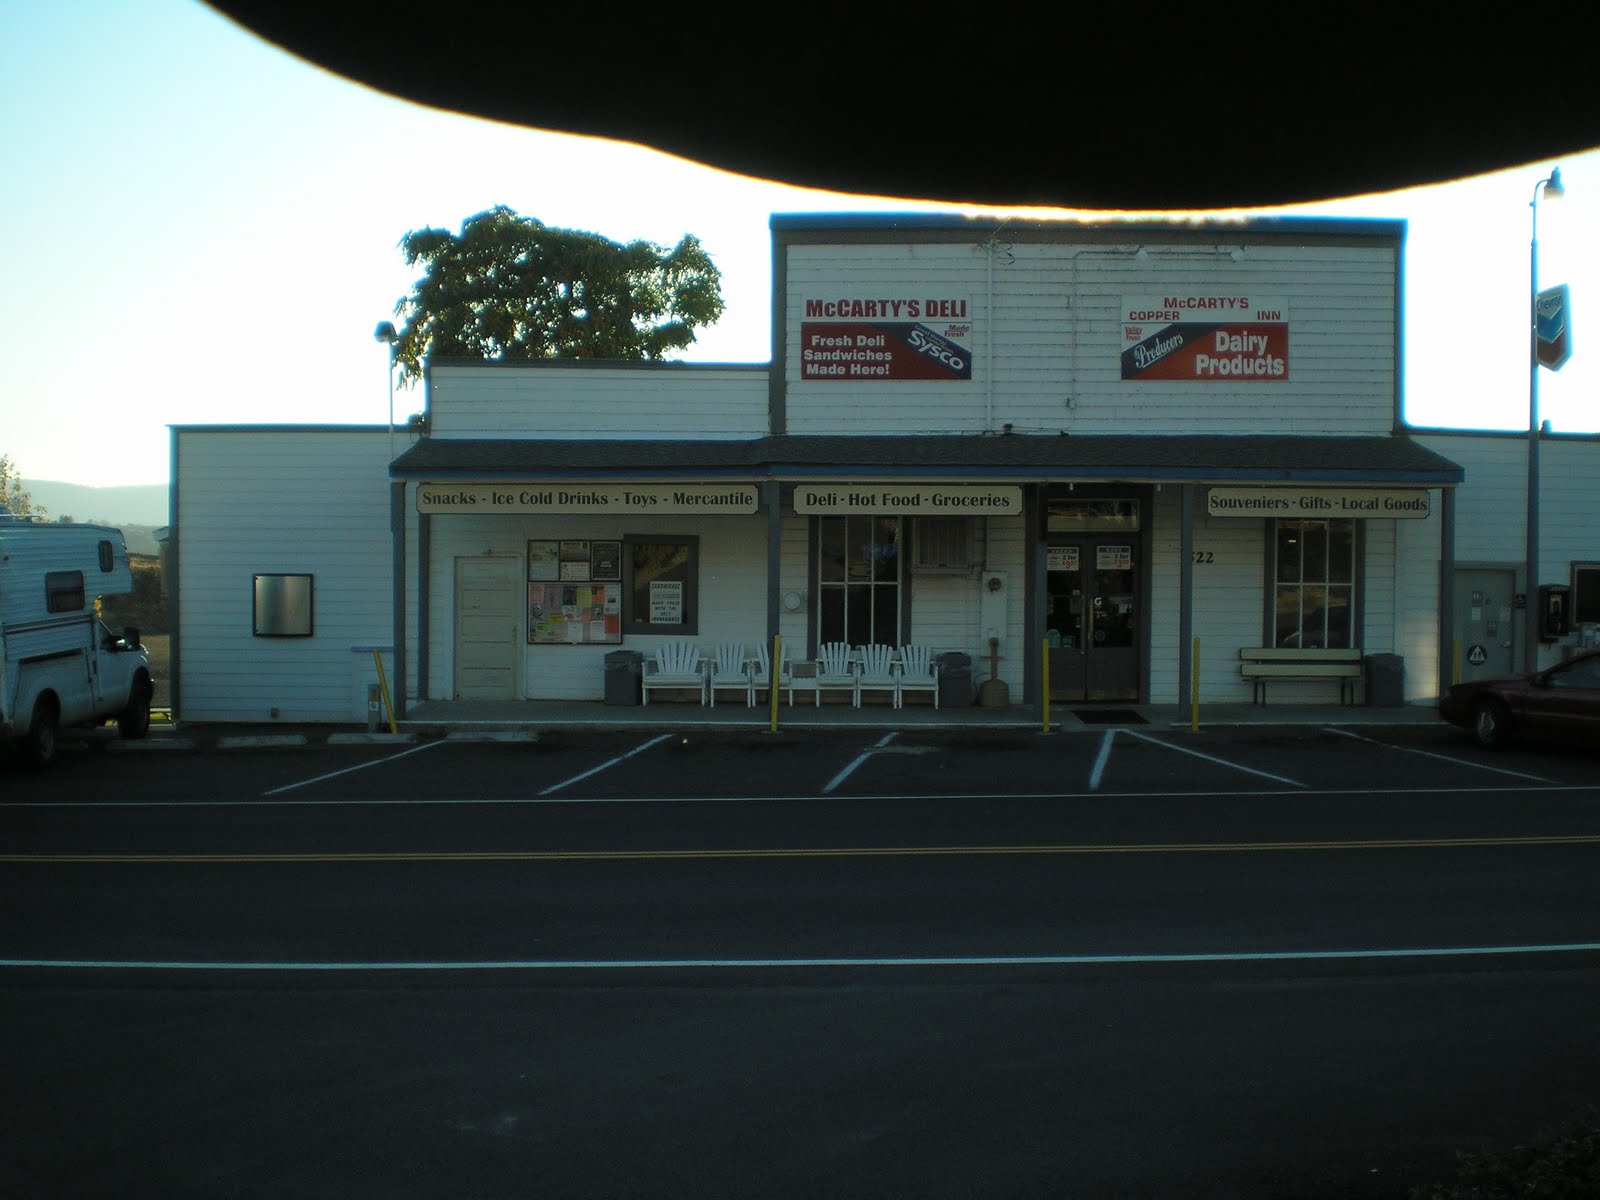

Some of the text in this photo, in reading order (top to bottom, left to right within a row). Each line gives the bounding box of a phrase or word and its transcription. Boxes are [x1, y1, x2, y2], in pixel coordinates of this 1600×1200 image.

[806, 299, 967, 318] McCARTY'S DELI
[1164, 297, 1249, 309] McCARTY'S
[1129, 311, 1281, 321] COPPER INN
[811, 335, 885, 346] Fresh Deli
[1215, 330, 1268, 356] Dairy
[804, 349, 892, 361] Sandwiches
[806, 363, 890, 375] Made Here!
[1196, 354, 1285, 376] Products
[422, 492, 476, 506] Snacks
[492, 491, 515, 505] Ice
[519, 491, 552, 505] Cold
[558, 491, 608, 505] Drinks
[624, 491, 657, 508] Toys
[672, 491, 753, 505] Mercantile
[806, 493, 837, 506] Deli
[849, 493, 876, 506] Hot
[882, 493, 921, 506] Food
[932, 493, 1010, 507] Groceries
[1210, 495, 1289, 509] Souveniers
[1299, 496, 1332, 509] Gifts
[1342, 497, 1379, 510] Local
[1384, 497, 1428, 511] Goods
